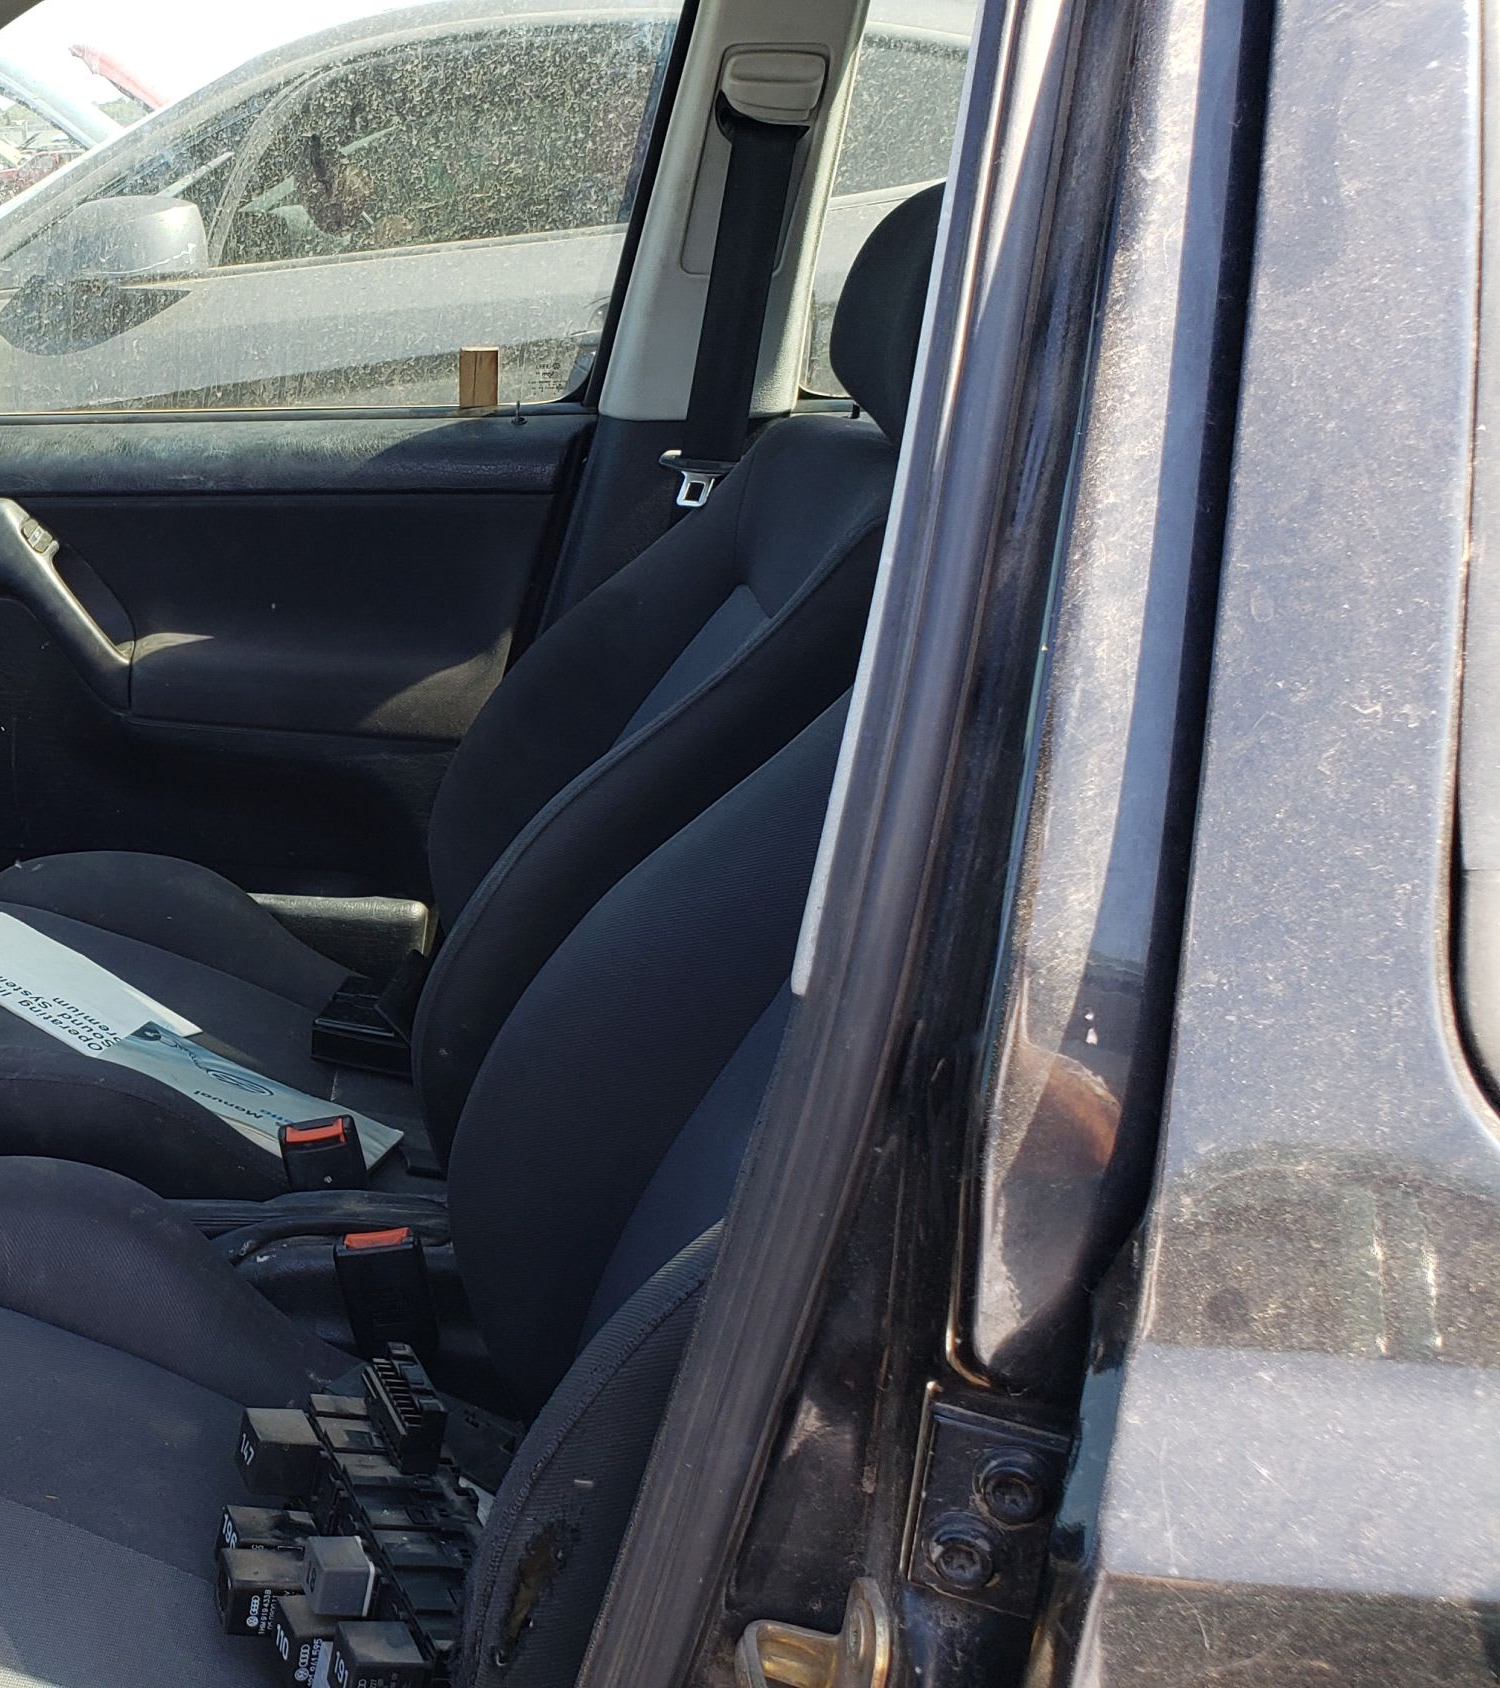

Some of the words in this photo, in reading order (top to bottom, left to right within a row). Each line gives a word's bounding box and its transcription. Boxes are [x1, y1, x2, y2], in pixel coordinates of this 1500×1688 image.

[18, 999, 103, 1051] Operating
[59, 1012, 115, 1048] Sound
[193, 1090, 262, 1120] Manual
[240, 1433, 255, 1466] 147
[276, 1623, 290, 1661] 110
[334, 1651, 349, 1688] 191
